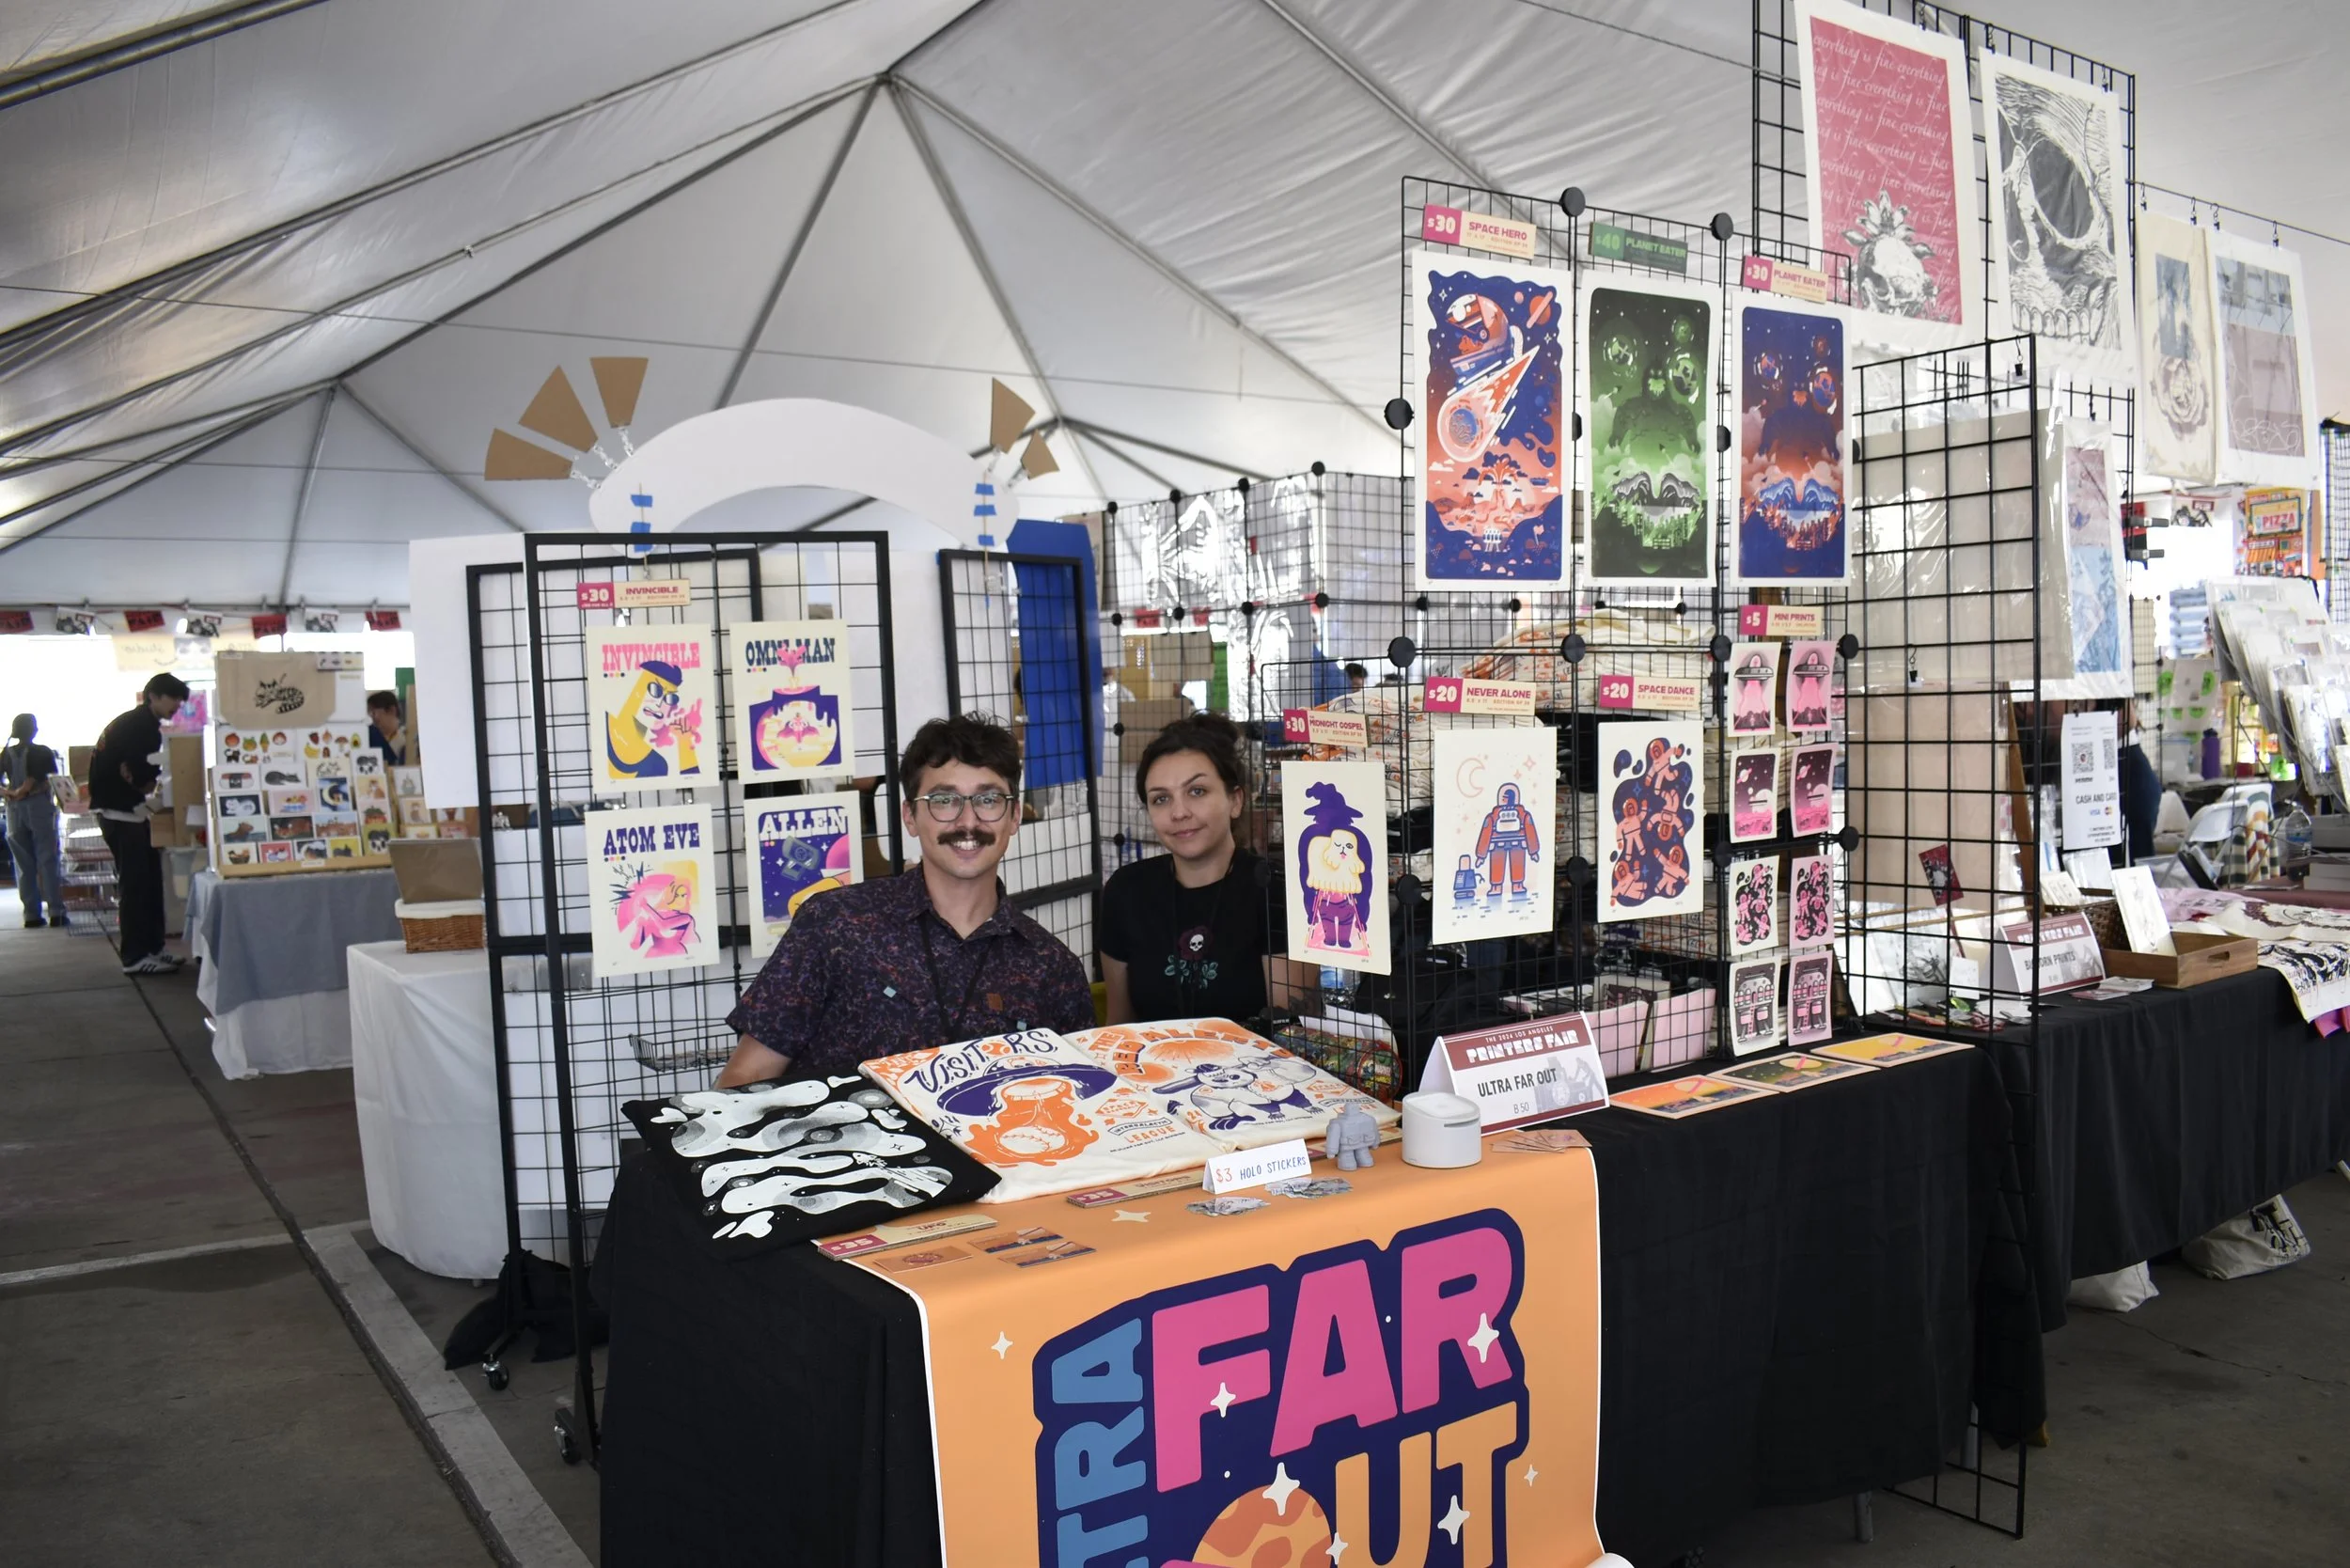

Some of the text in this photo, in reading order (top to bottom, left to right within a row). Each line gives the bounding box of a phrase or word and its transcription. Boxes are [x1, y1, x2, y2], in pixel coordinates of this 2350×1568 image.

[1427, 214, 1456, 234] $30
[1469, 222, 1500, 235] SPACE
[1501, 227, 1527, 241] HERO
[1625, 237, 1686, 258] PLANET EATER
[1747, 264, 1768, 281] $30
[1774, 270, 1826, 288] PLANET EATER
[2263, 512, 2295, 529] PIZZA
[582, 588, 609, 602] $30
[626, 587, 679, 595] INVINCIBLE
[1746, 611, 1761, 627] $5
[1791, 613, 1815, 621] PRINTS
[602, 642, 700, 671] INVINCIBLE
[1429, 684, 1457, 702] $20
[1466, 687, 1531, 698] NEVER ALONE
[1603, 682, 1629, 698] $20
[1638, 684, 1695, 695] SPACE DANCE
[1286, 716, 1306, 733] $30
[1309, 719, 1364, 730] MIDNIGHT GOSPEL
[2076, 795, 2092, 805] CASH
[2093, 793, 2105, 803] AND
[760, 808, 849, 841] ALLEN
[603, 823, 700, 855] ATOM EVE
[1528, 1026, 1554, 1036] ANGELES
[1089, 1032, 1124, 1052] THE
[1466, 1029, 1579, 1063] PRINTERS FAIR
[1478, 1068, 1557, 1098] ULTRA FAR OUT
[1513, 1102, 1529, 1114] B 50
[1124, 1125, 1176, 1143] LEAGUE
[1216, 1156, 1307, 1184] $3 HOLO STICKERS
[917, 1221, 948, 1231] UFO
[830, 1238, 874, 1251] $35
[1152, 1227, 1512, 1493] FAR
[1052, 1318, 1149, 1568] TRA
